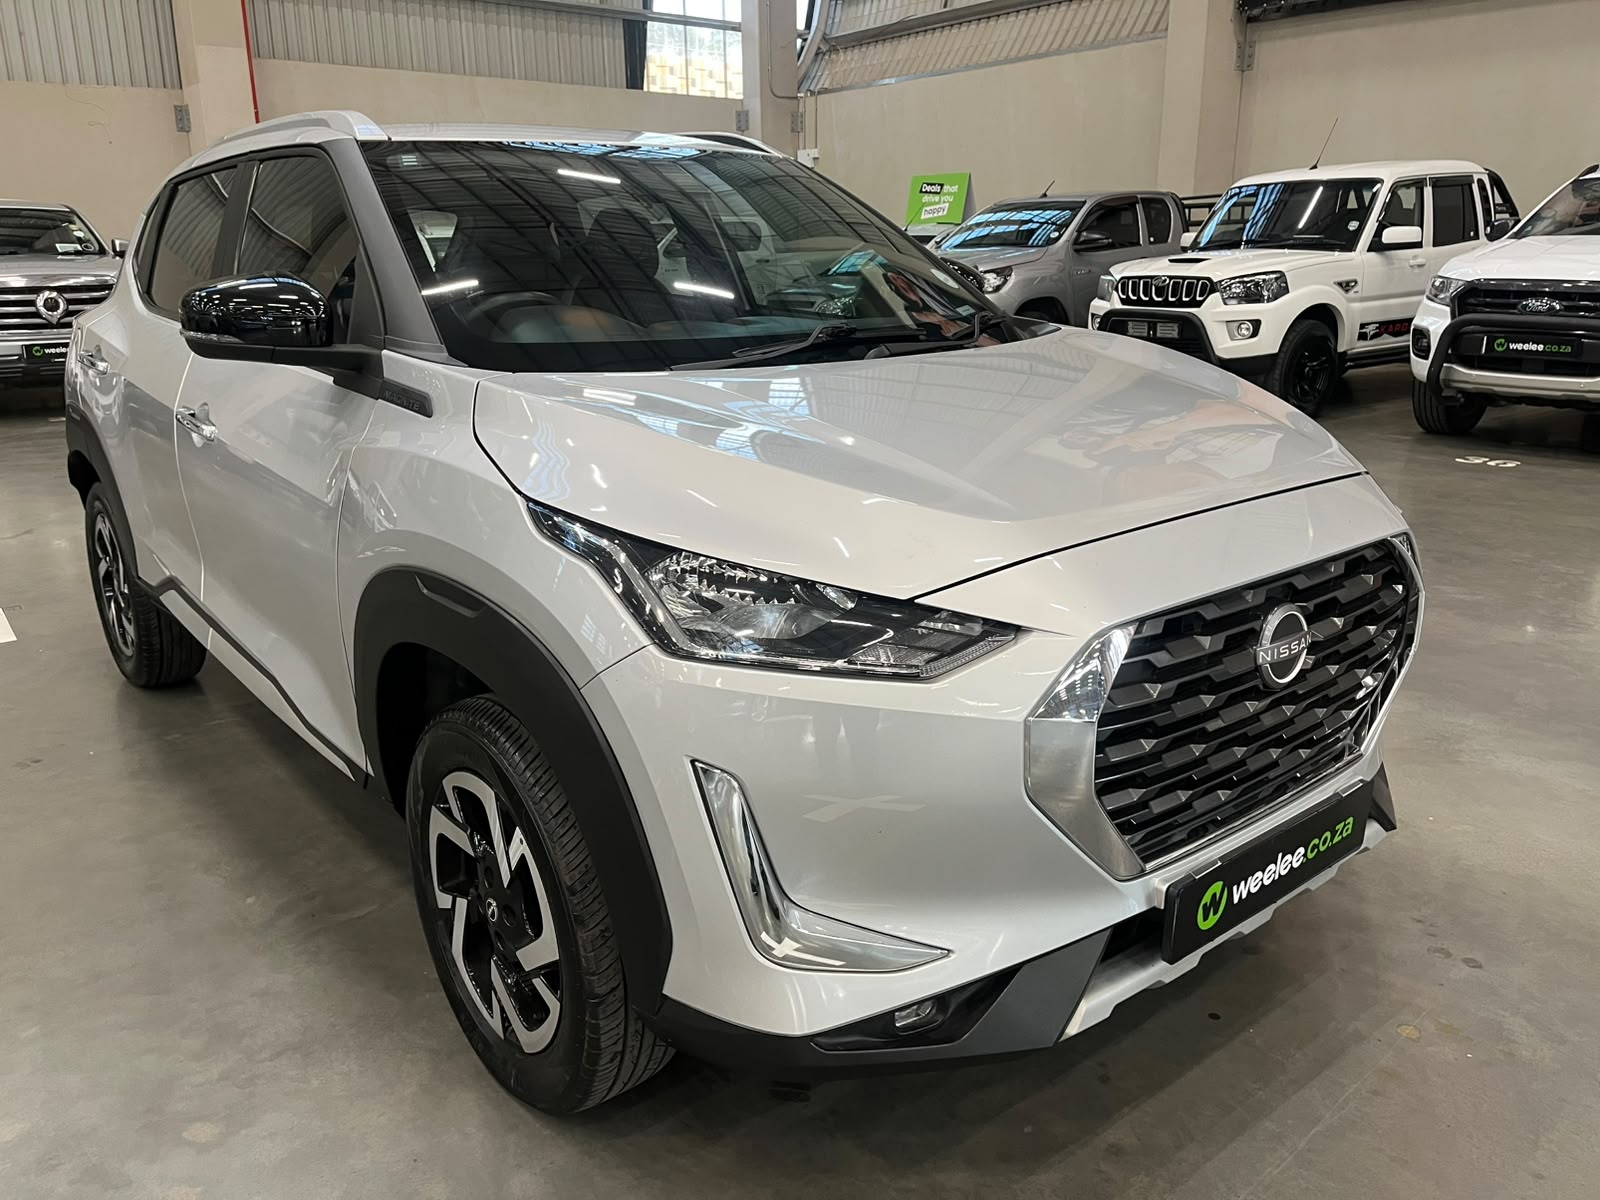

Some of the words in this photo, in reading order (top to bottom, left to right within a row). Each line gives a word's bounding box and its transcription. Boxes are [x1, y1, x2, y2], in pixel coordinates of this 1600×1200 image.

[921, 183, 941, 193] Deals
[943, 184, 958, 193] that
[921, 194, 940, 203] drive
[940, 195, 954, 204] you
[923, 205, 947, 217] happy
[1380, 322, 1410, 334] KARO
[44, 346, 69, 354] weele
[1508, 341, 1572, 353] weelee.co.za
[1455, 456, 1520, 467] 36
[1259, 631, 1312, 664] NISSAN
[1233, 816, 1354, 904] weelee.co.za
